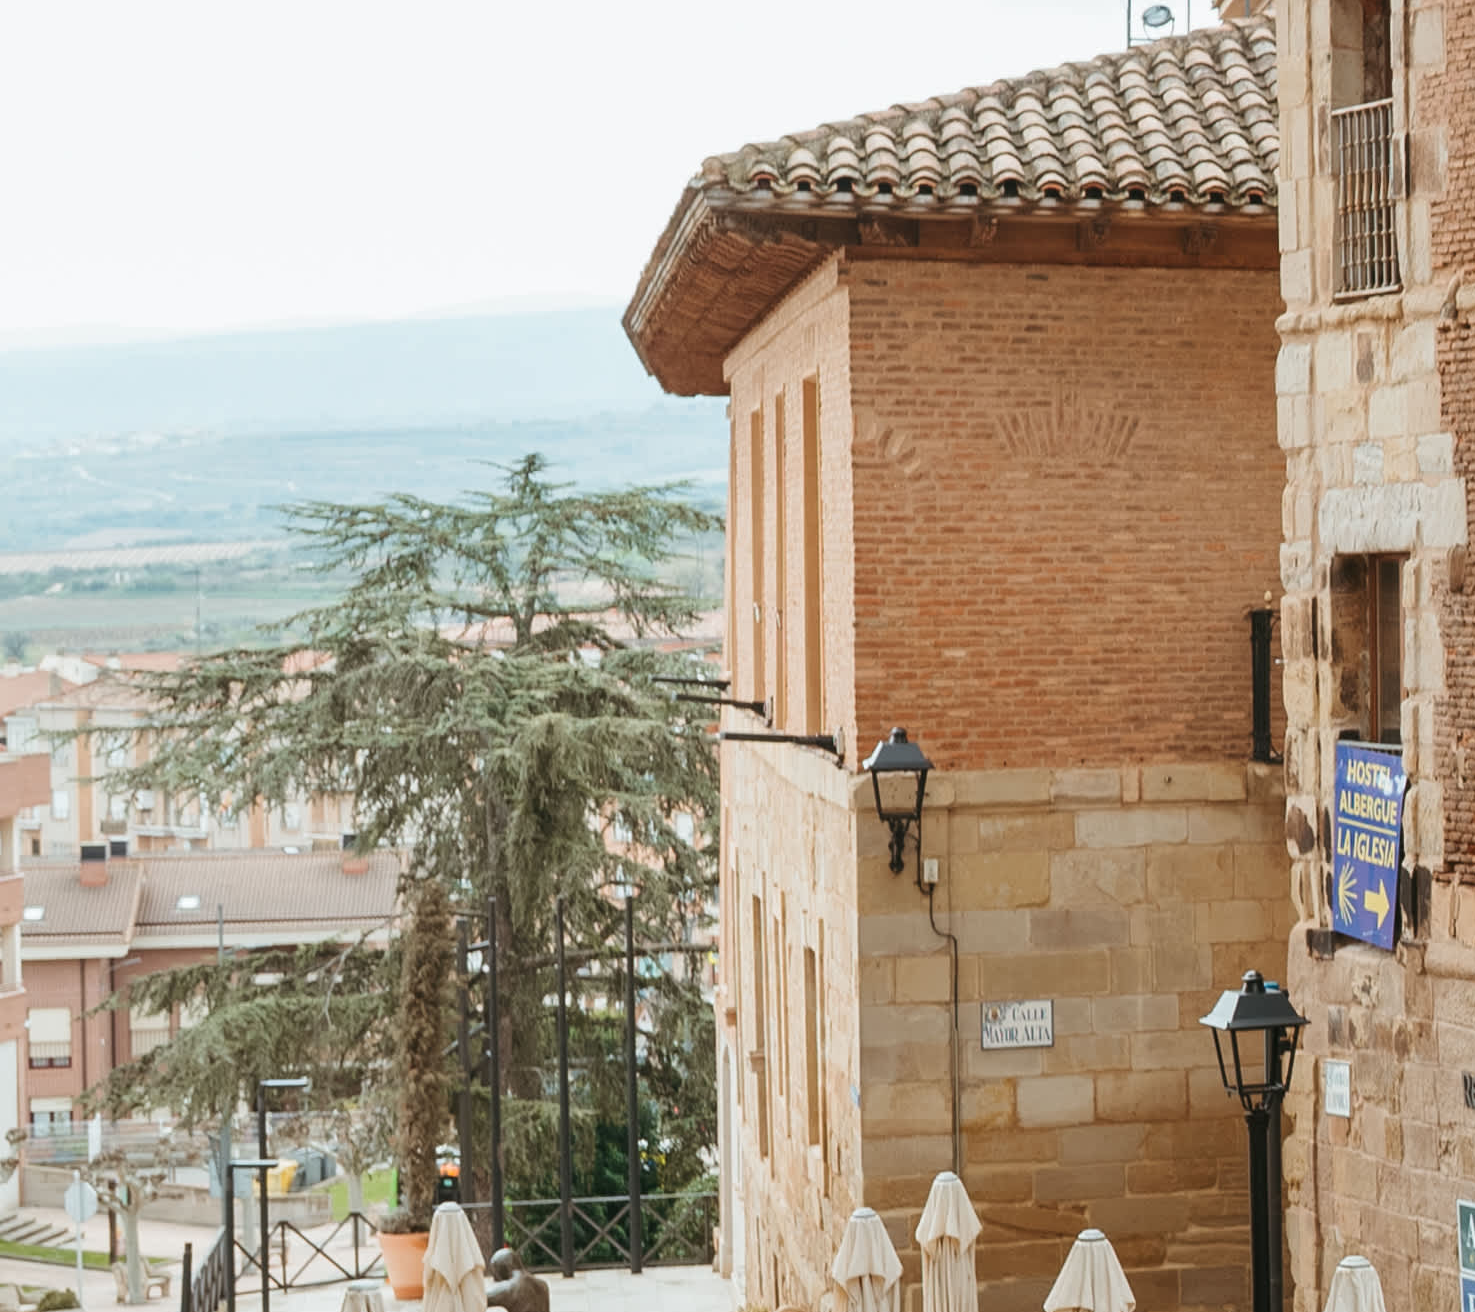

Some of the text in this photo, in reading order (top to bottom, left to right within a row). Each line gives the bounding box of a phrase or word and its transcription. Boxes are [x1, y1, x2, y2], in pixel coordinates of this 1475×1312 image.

[1340, 789, 1398, 826] ALBERGUE
[1337, 827, 1396, 869] LA IGLESIA
